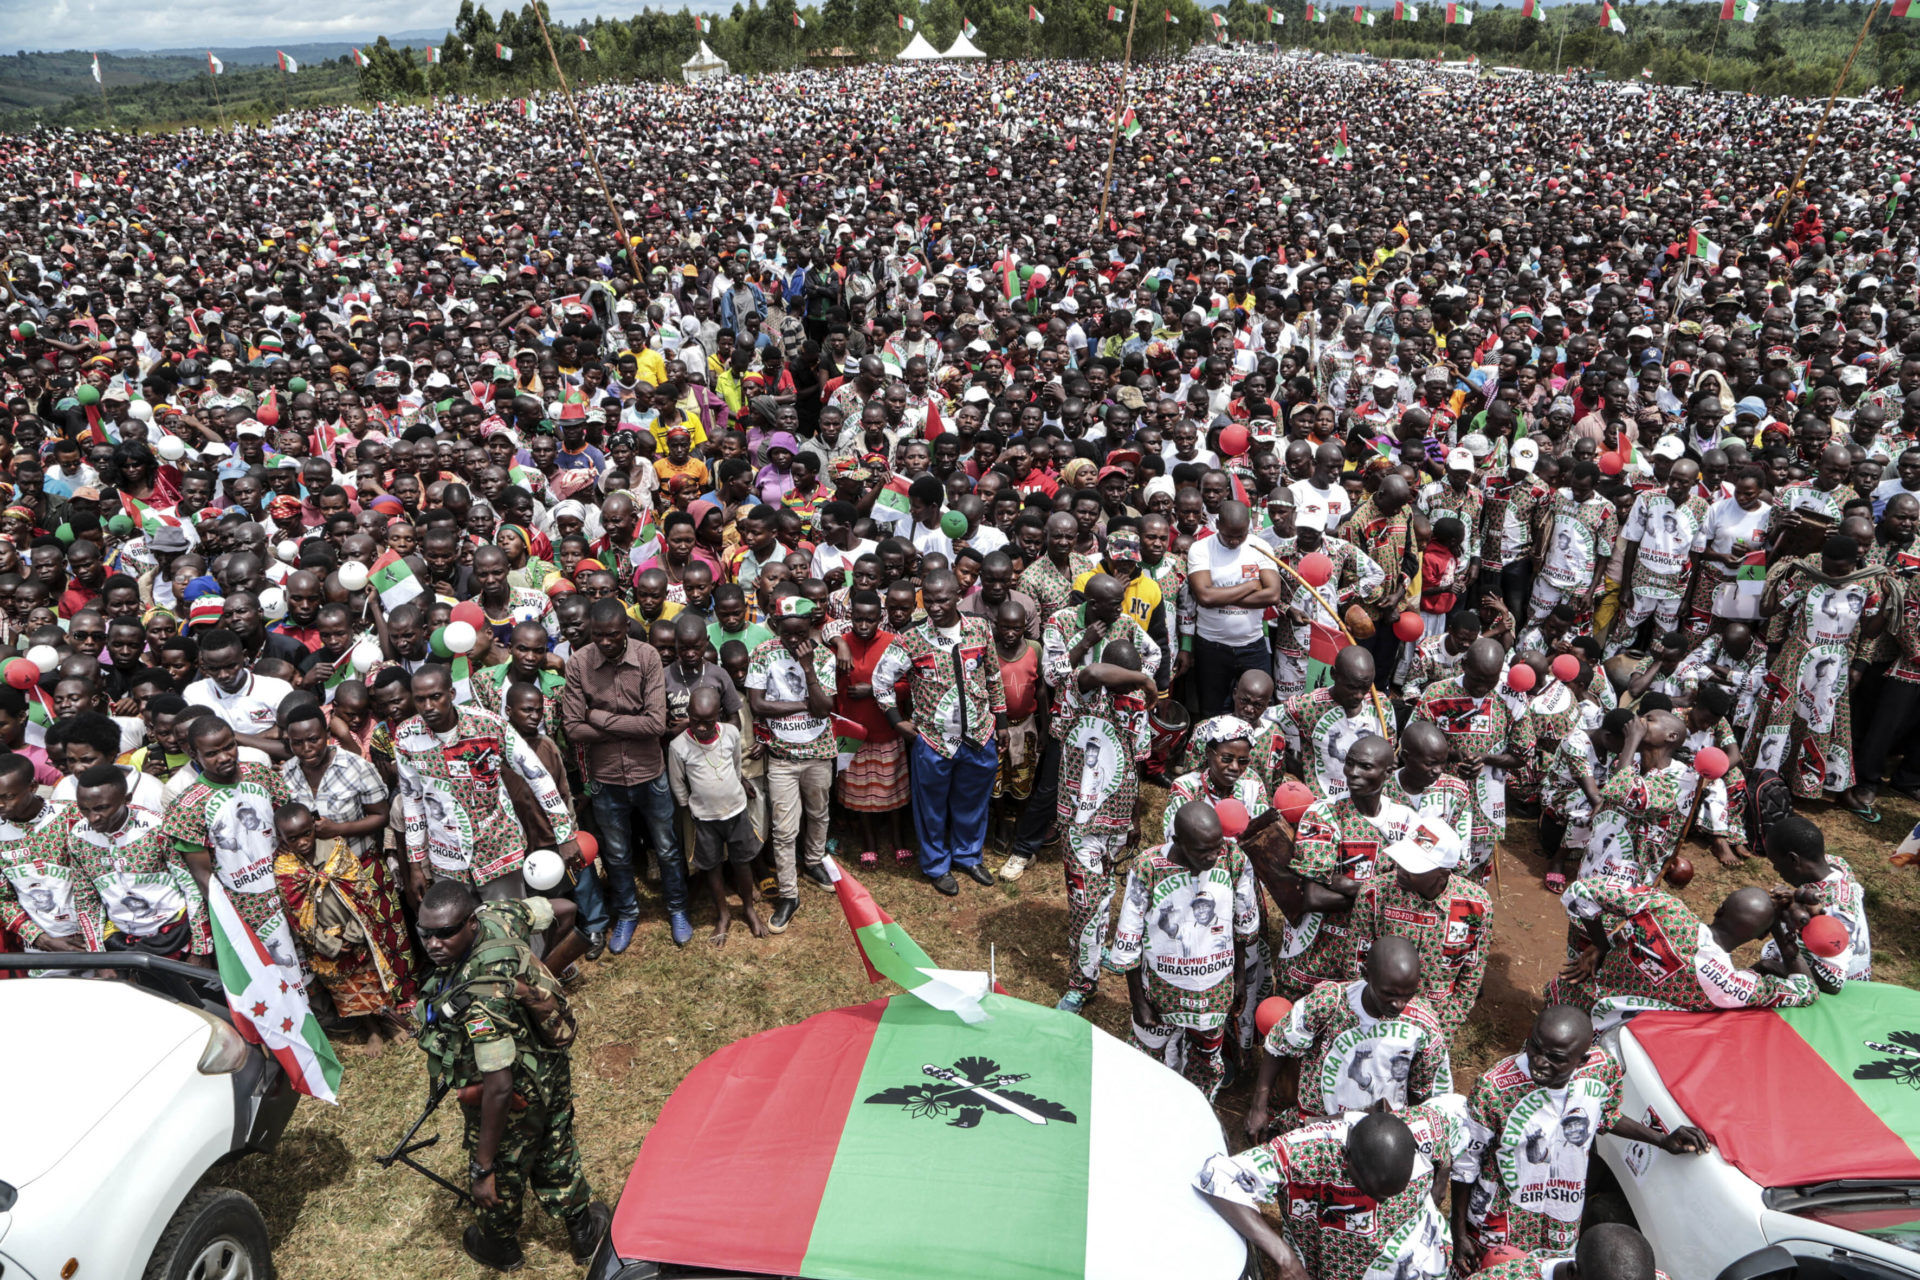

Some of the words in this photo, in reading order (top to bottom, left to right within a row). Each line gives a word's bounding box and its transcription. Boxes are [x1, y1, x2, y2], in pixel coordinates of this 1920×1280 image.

[1130, 598, 1150, 620] NY
[770, 719, 824, 731] BIRASHOBOKA
[1315, 745, 1325, 775] TORA
[1477, 773, 1486, 804] TORA
[230, 866, 247, 880] TURI
[1157, 956, 1175, 964] TURI
[1178, 956, 1207, 966] KUMWE
[1157, 958, 1234, 976] BIRASHOBOKA
[1708, 958, 1729, 975] TURI
[1182, 998, 1207, 1008] 2020
[1323, 1056, 1342, 1095] TORA
[1335, 1023, 1409, 1054] EVARISTE
[1502, 1149, 1519, 1191] TORA
